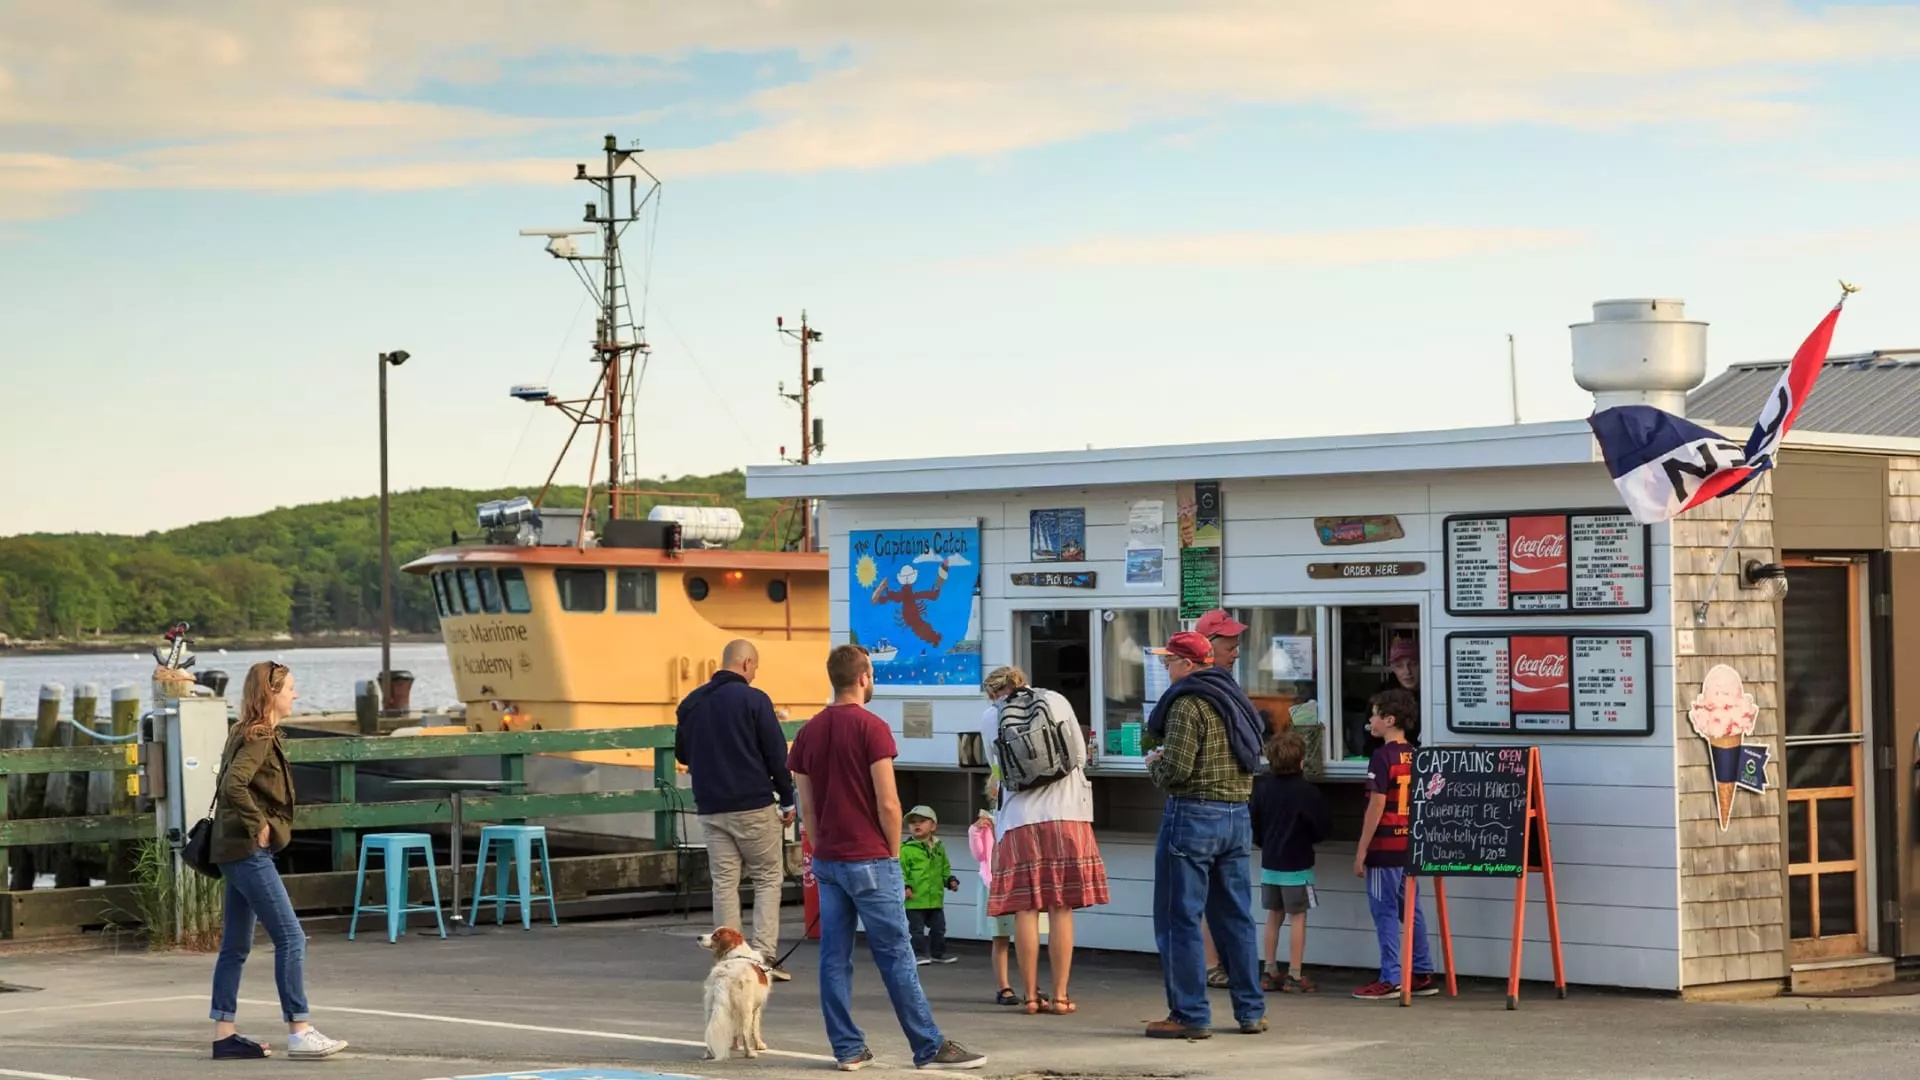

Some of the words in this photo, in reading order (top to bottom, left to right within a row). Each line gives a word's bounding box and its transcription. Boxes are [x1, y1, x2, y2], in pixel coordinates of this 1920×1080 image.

[933, 532, 968, 554] Catch
[1512, 534, 1565, 558] Coca-Cola
[1343, 565, 1372, 577] ORDER
[1375, 564, 1400, 576] HERE
[469, 620, 528, 644] Maritime
[462, 652, 514, 681] Academy
[1514, 654, 1567, 677] Coca-Cola
[1416, 750, 1494, 774] CAPTAIN'S
[1498, 749, 1522, 762] OPEN
[1446, 782, 1481, 797] FRESH
[1484, 781, 1521, 798] BAKED
[1483, 803, 1501, 820] PIE
[1432, 844, 1466, 860] Clams
